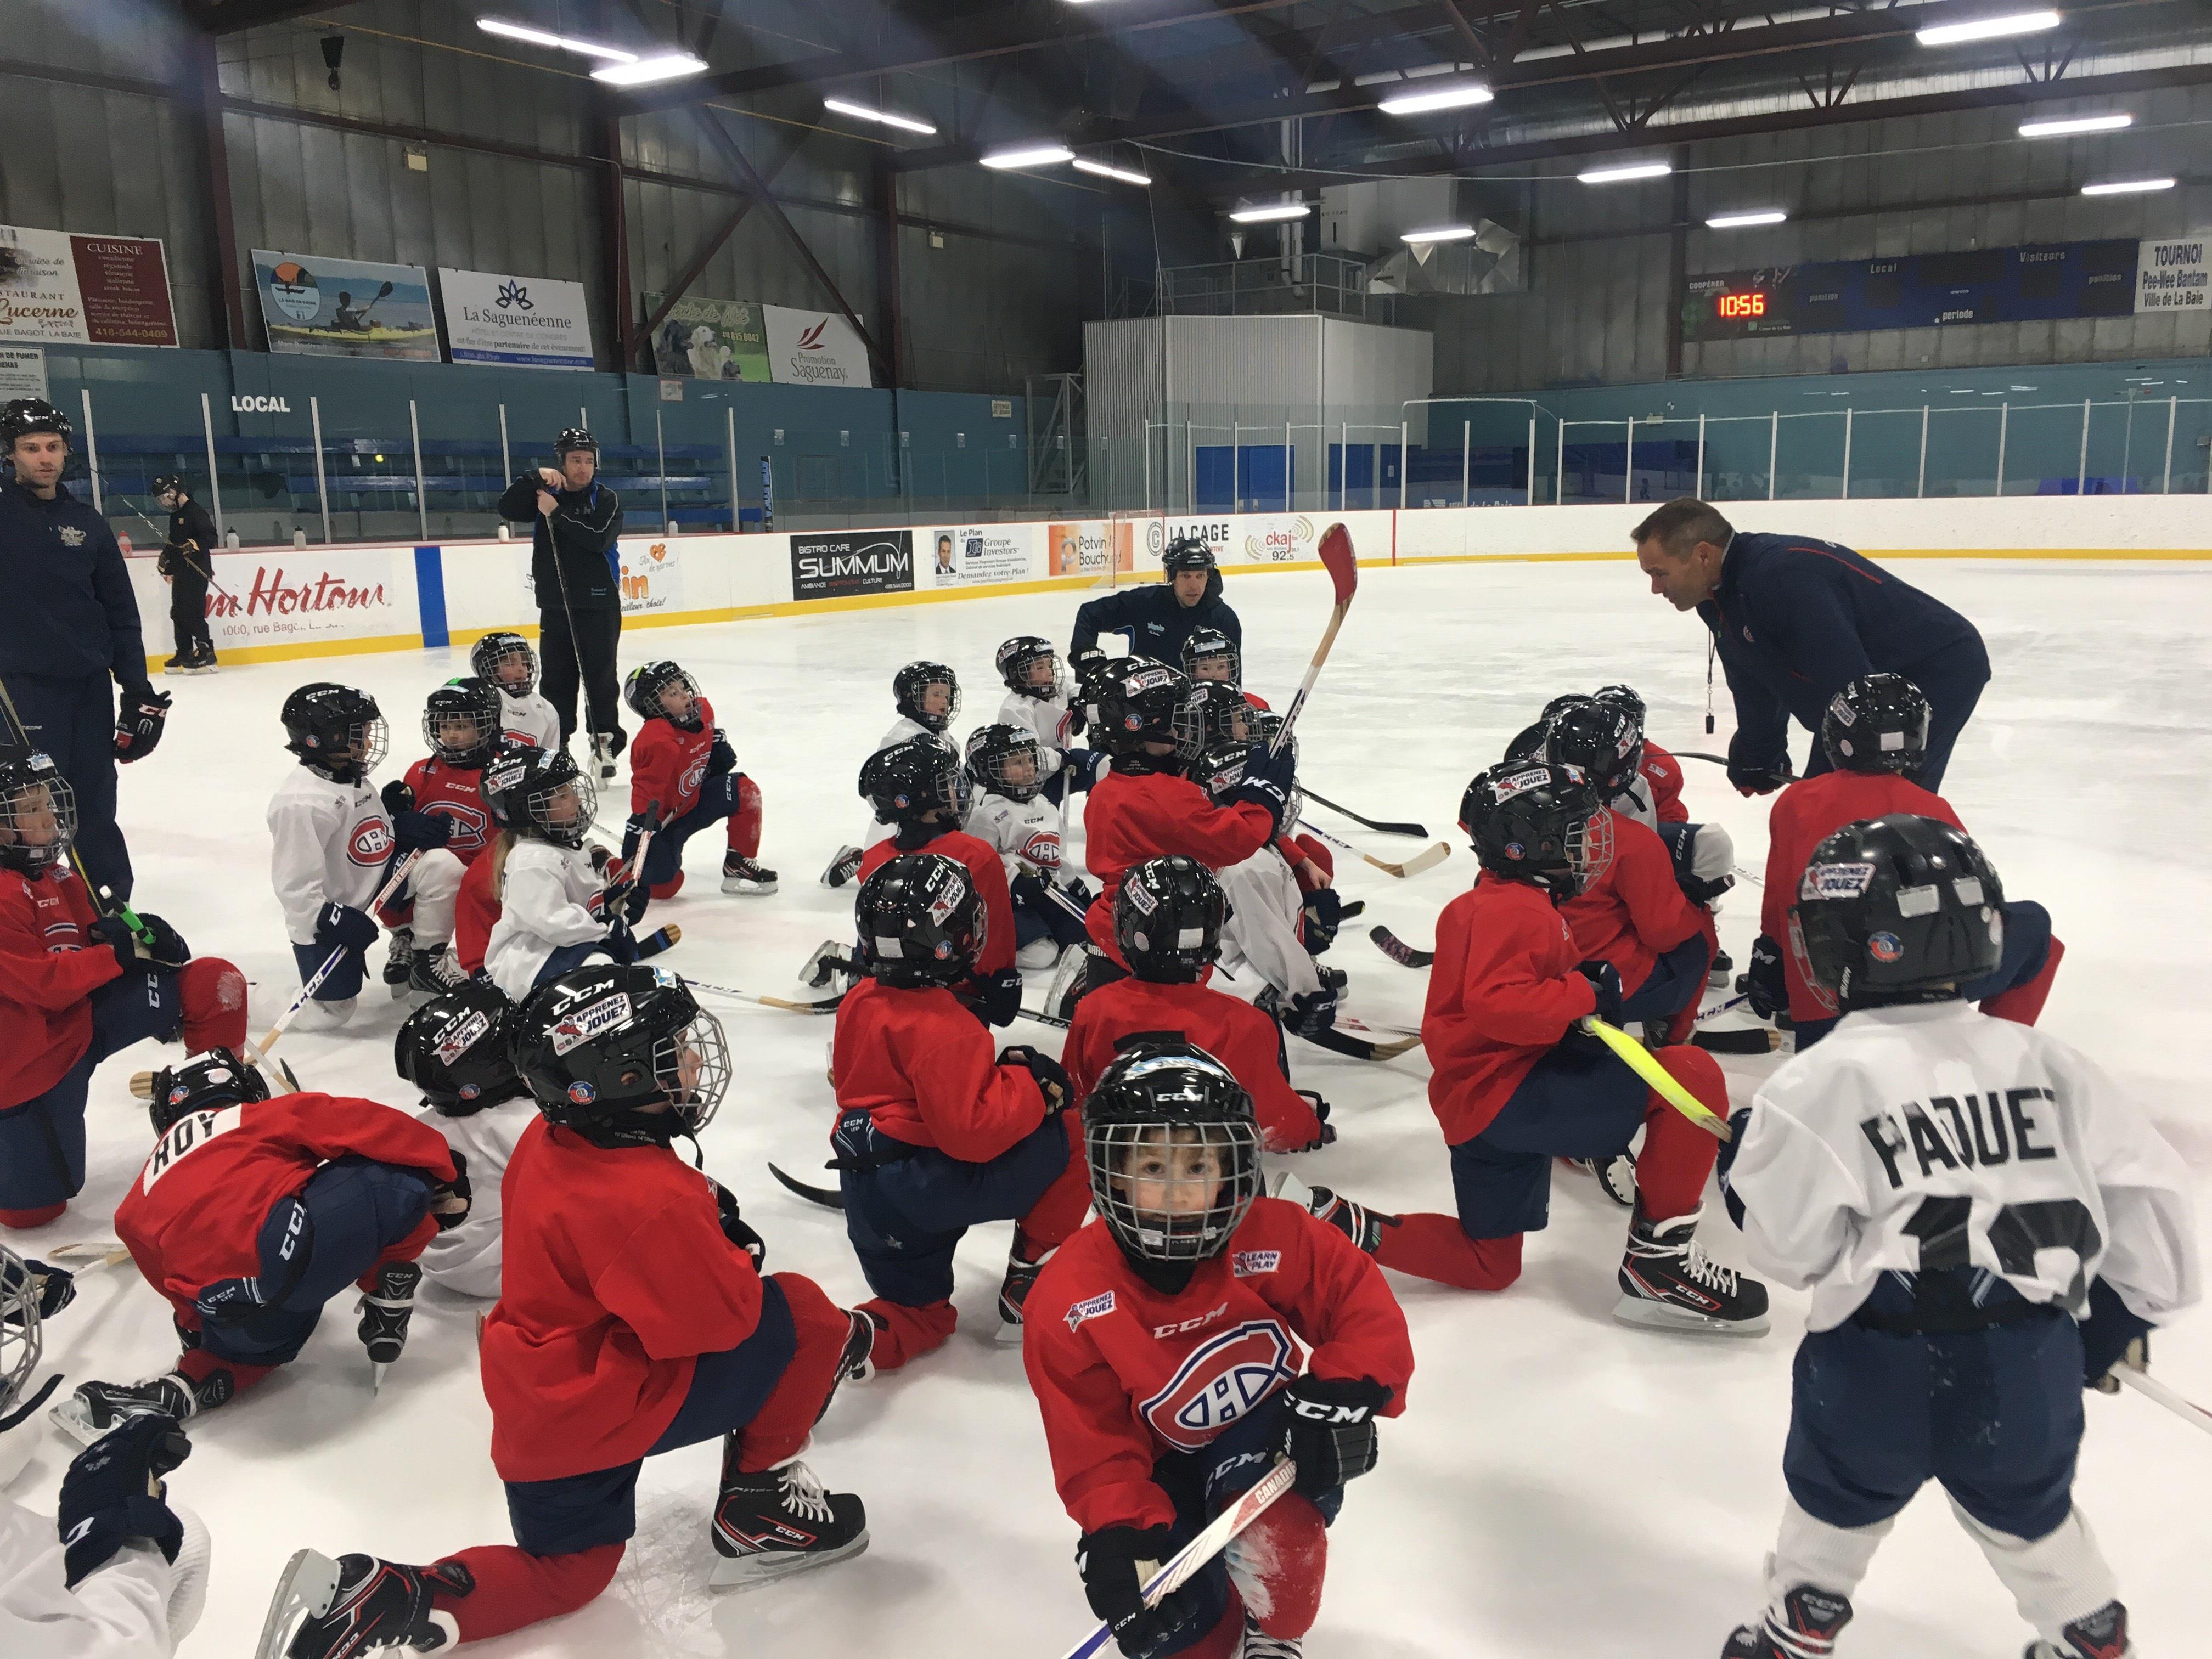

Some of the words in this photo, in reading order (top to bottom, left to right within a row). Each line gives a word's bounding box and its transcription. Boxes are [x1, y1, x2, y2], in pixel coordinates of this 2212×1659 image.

[87, 242, 143, 255] CUISINE
[2154, 244, 2203, 267] TOURNOI
[2020, 252, 2065, 263] Visiteurs
[1870, 263, 1896, 274] Local
[2143, 270, 2175, 290] Pee-Wee
[2177, 269, 2208, 288] Bantam
[1720, 294, 1764, 317] 10:56
[2144, 293, 2160, 307] Ville
[2163, 292, 2172, 306] de
[2174, 292, 2183, 306] La
[2186, 290, 2204, 305] Baie
[464, 307, 480, 322] La
[483, 309, 571, 328] Saguenéenne
[494, 340, 530, 350] partenaire
[797, 352, 836, 365] Promotion
[791, 358, 847, 383] Saguenay
[231, 396, 291, 413] LOCAL
[969, 528, 982, 537] Plan
[1191, 524, 1229, 541] CAGE
[798, 545, 828, 554] BISTRO
[830, 544, 851, 552] CAFE
[984, 538, 1011, 548] Groupe
[1079, 535, 1107, 550] Potvin
[1266, 530, 1292, 554] ckaj
[984, 548, 1018, 556] Investors
[798, 553, 908, 579] SUMMUM
[958, 571, 992, 579] Demandez
[621, 600, 643, 612] eilleur
[254, 625, 270, 634] rue
[306, 689, 339, 700] CCM
[884, 746, 914, 761] CCM
[1086, 752, 1099, 771] CCM
[489, 757, 522, 774] CCM
[1512, 769, 1546, 783] APPRENEZ
[1519, 774, 1549, 788] JOUEZ
[445, 782, 476, 793] CCM
[1024, 816, 1045, 824] CCM
[1676, 829, 1687, 861] CCM
[925, 862, 945, 892] CCM
[551, 979, 615, 1015] CCM
[576, 995, 625, 1023] APPRENEZ
[432, 1006, 471, 1045] CCM
[586, 1002, 627, 1034] JOUEZ
[1156, 1093, 1204, 1102] CCM
[843, 1118, 864, 1128] CCM
[1860, 1087, 2062, 1190] PAQUE
[1247, 1252, 1277, 1262] LEARN
[1251, 1261, 1275, 1270] PLAY
[207, 1286, 236, 1304] CCM
[1079, 1293, 1112, 1310] APPRENEZ
[1675, 1284, 1709, 1305] CCM
[1085, 1300, 1113, 1316] JOUEZ
[1153, 1302, 1228, 1339] CCM
[775, 1525, 806, 1541] CCM
[1115, 1612, 1136, 1631] CCM
